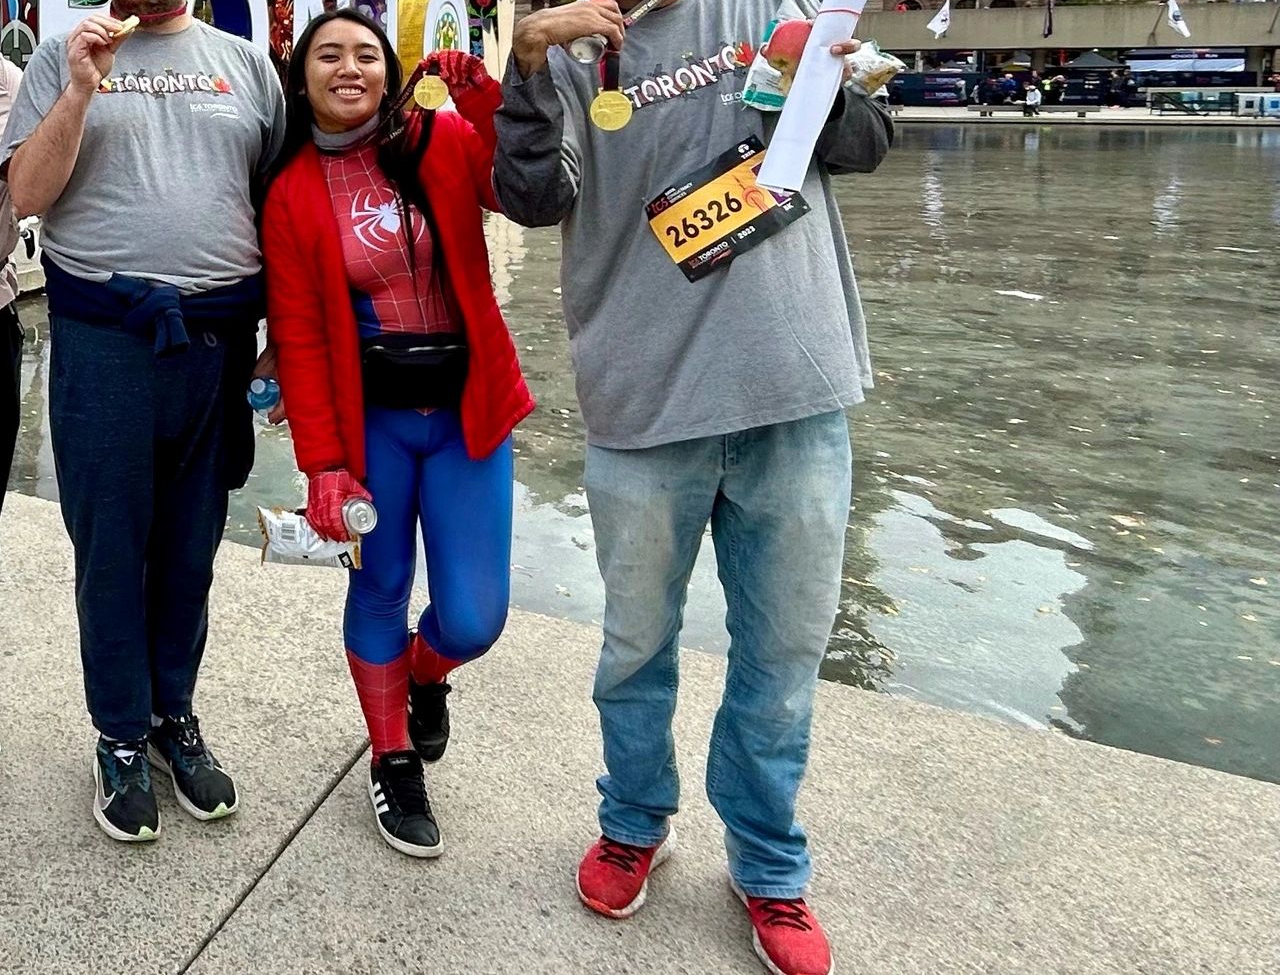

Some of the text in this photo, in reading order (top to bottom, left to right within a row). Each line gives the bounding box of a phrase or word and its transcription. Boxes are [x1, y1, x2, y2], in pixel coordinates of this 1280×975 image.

[111, 74, 211, 93] TORONTO
[623, 45, 736, 108] TORONTO
[666, 191, 743, 248] 26326
[698, 241, 729, 261] TORONTO
[737, 225, 756, 240] 2023
